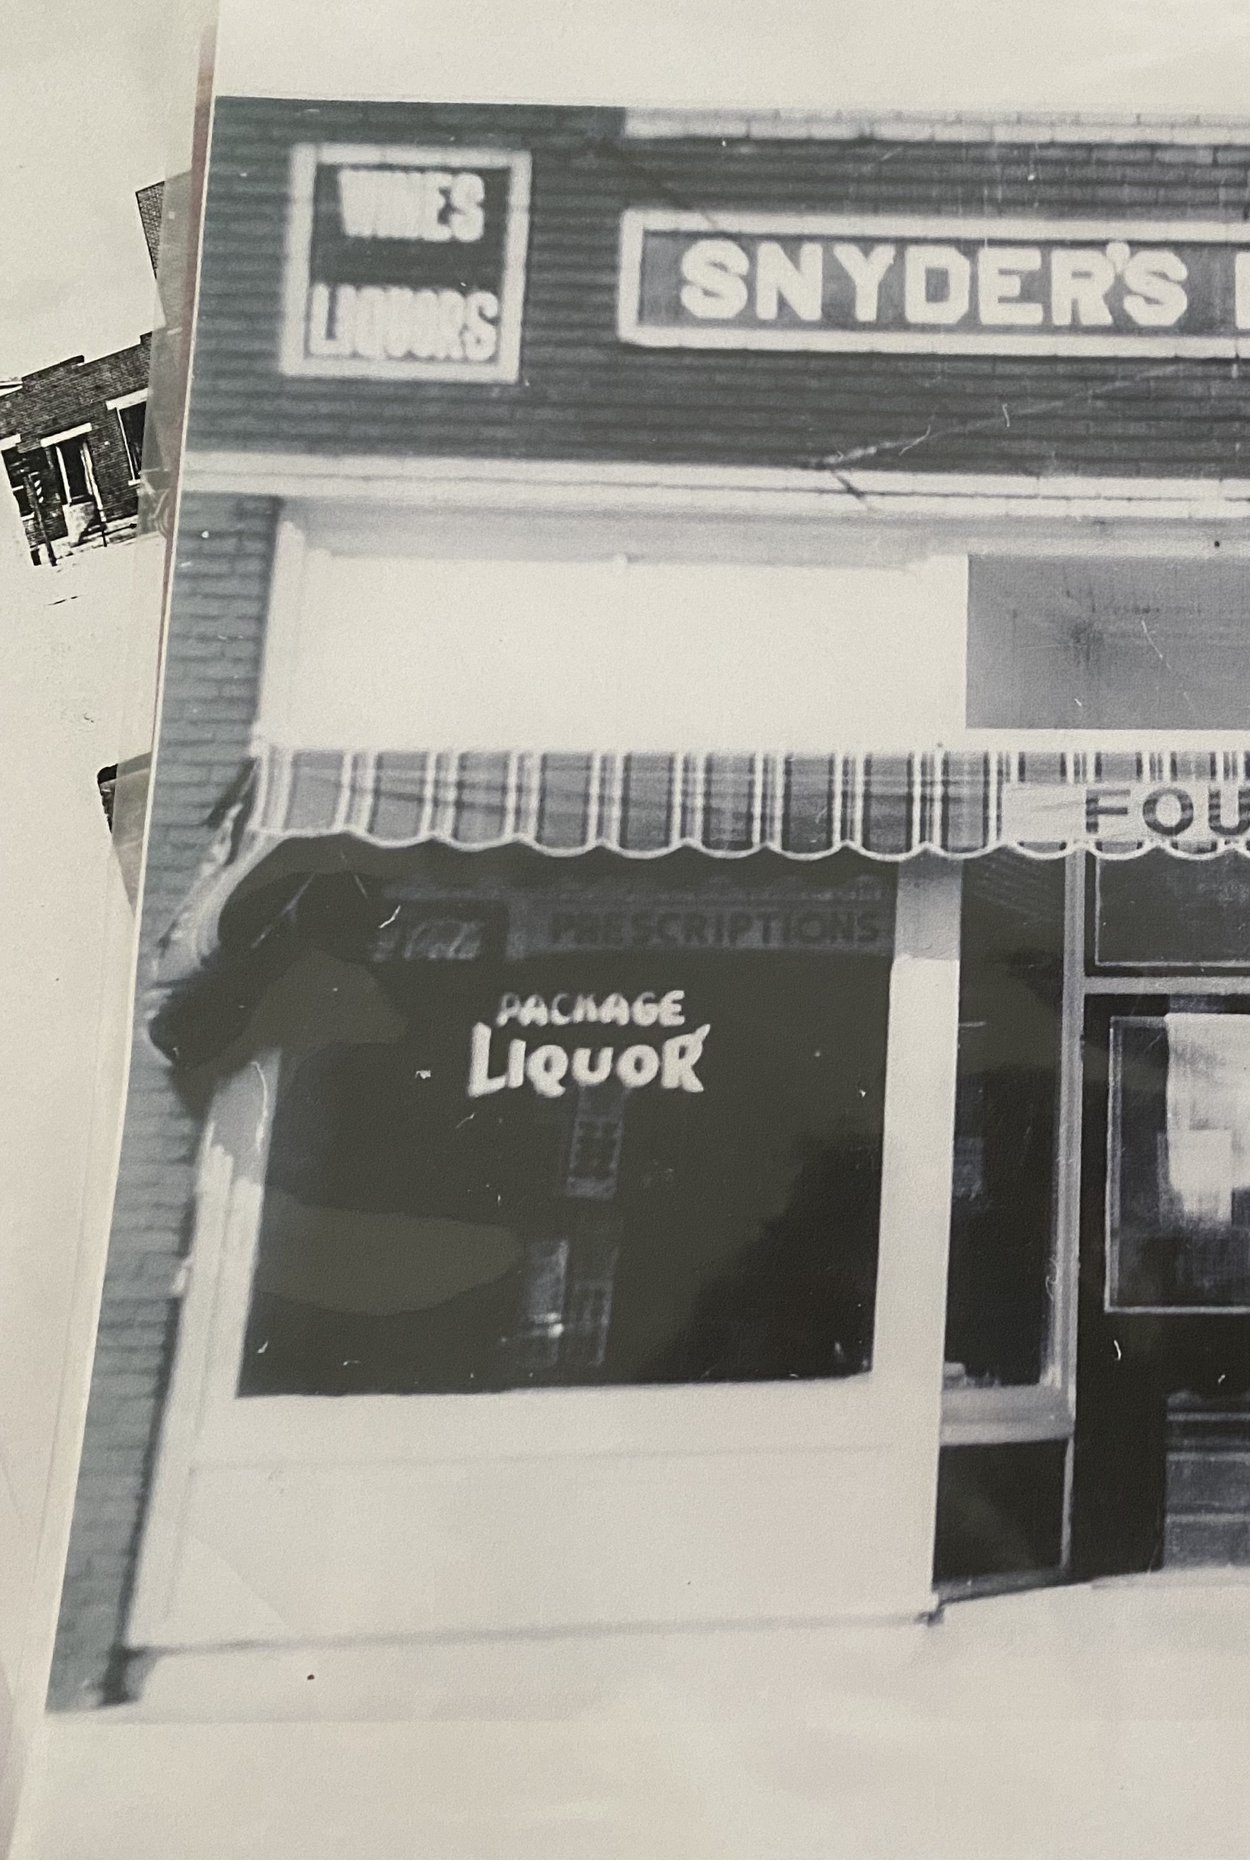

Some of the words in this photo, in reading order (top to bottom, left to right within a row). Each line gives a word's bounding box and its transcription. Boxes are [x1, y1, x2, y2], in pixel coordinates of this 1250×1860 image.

[679, 238, 1188, 327] SNYDER'S
[551, 910, 883, 945] PRESCRIPTIONS
[496, 988, 686, 1027] PACKAGE
[468, 1021, 711, 1098] LIQUOR
